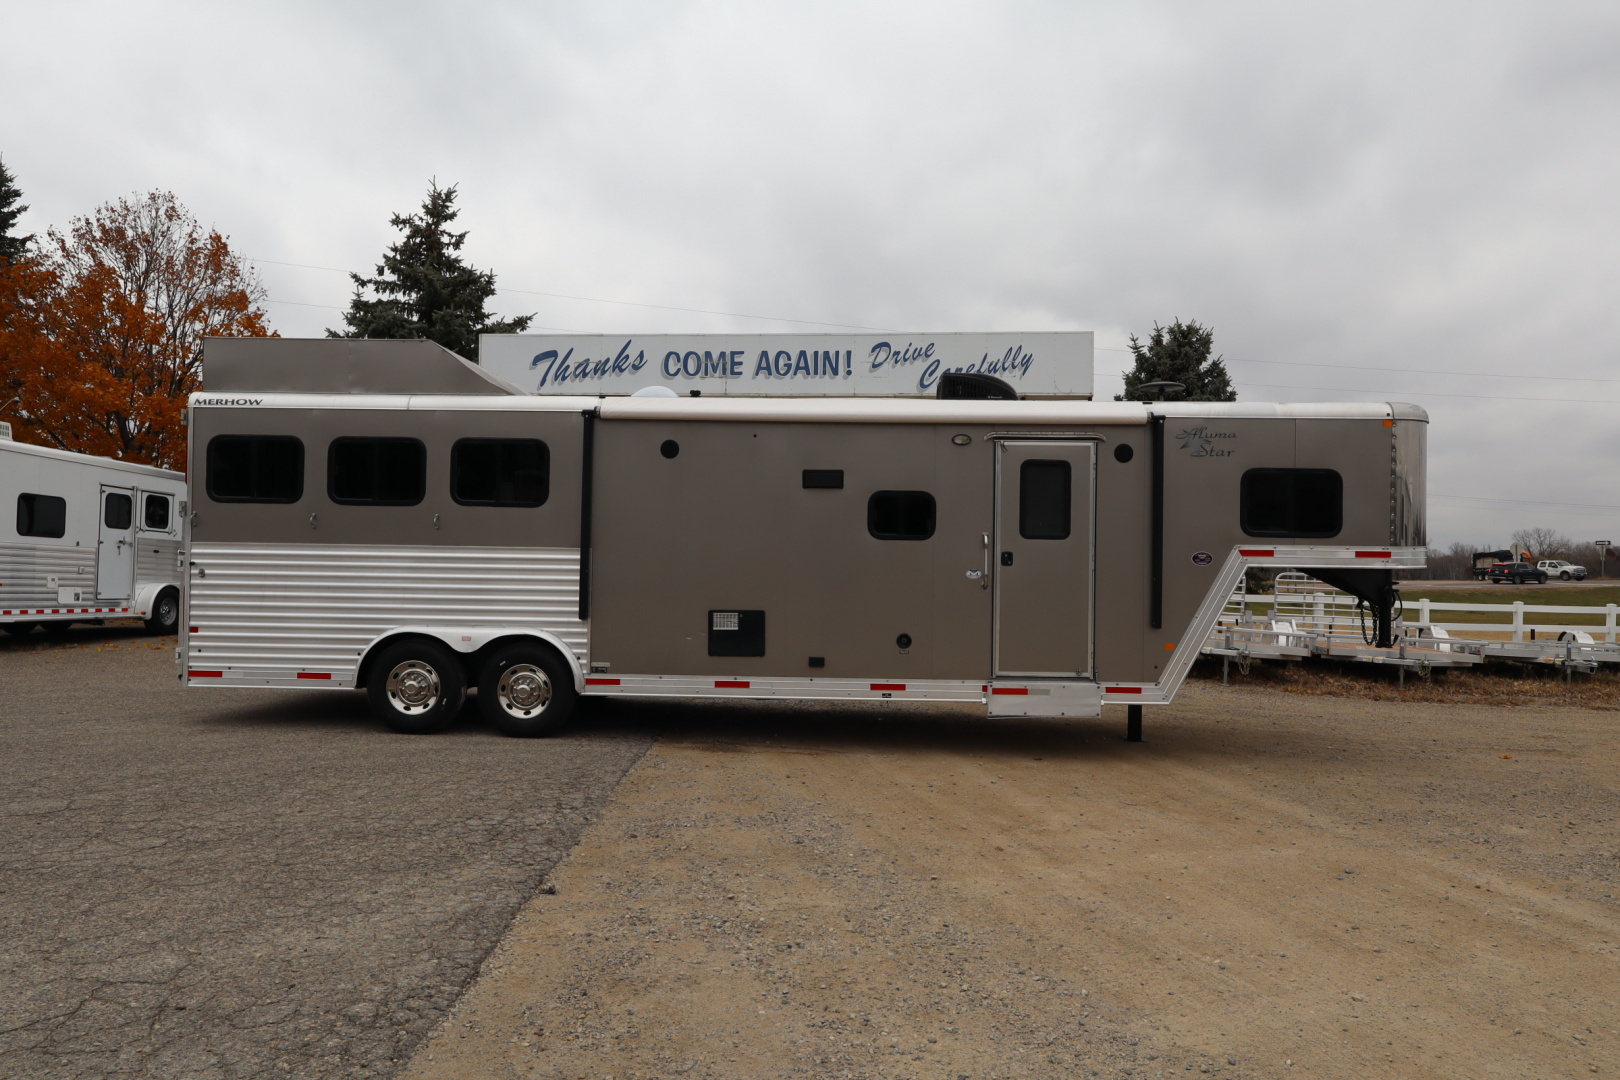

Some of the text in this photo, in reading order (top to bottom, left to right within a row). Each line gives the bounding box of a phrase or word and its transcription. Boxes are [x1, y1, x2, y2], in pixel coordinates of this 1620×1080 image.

[531, 339, 853, 388] Thanks COME AGAIN!
[870, 341, 935, 369] Drive
[193, 398, 263, 406] MERHOW
[1189, 442, 1235, 457] Star
